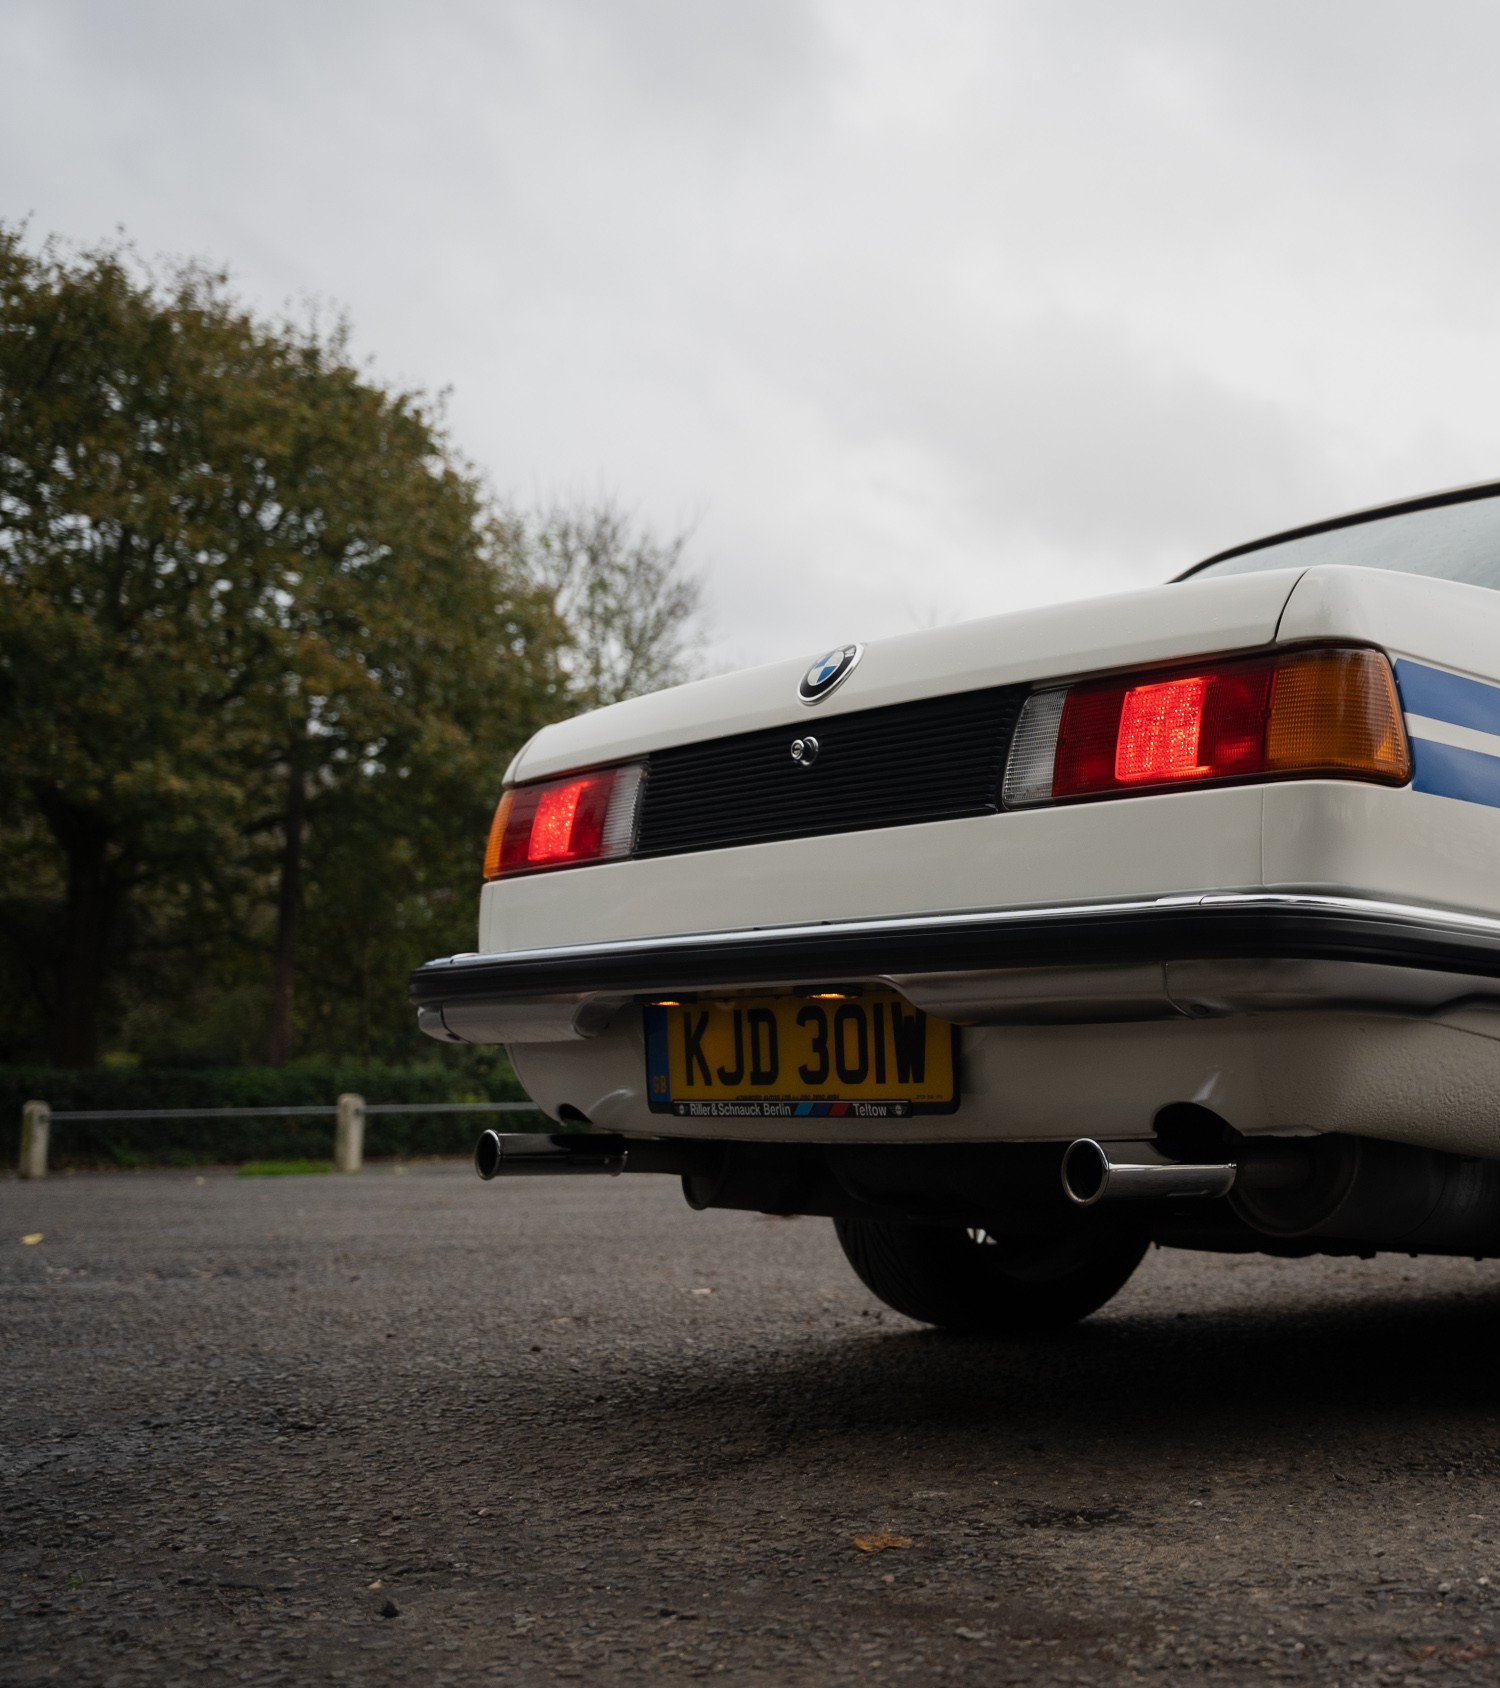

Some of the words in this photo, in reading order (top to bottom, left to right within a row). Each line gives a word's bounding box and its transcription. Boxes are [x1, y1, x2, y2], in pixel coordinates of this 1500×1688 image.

[684, 1008, 779, 1087] KJD
[796, 1002, 927, 1085] 301W
[653, 1074, 667, 1094] GB
[763, 1102, 792, 1116] Berlin
[853, 1103, 887, 1117] Teltow
